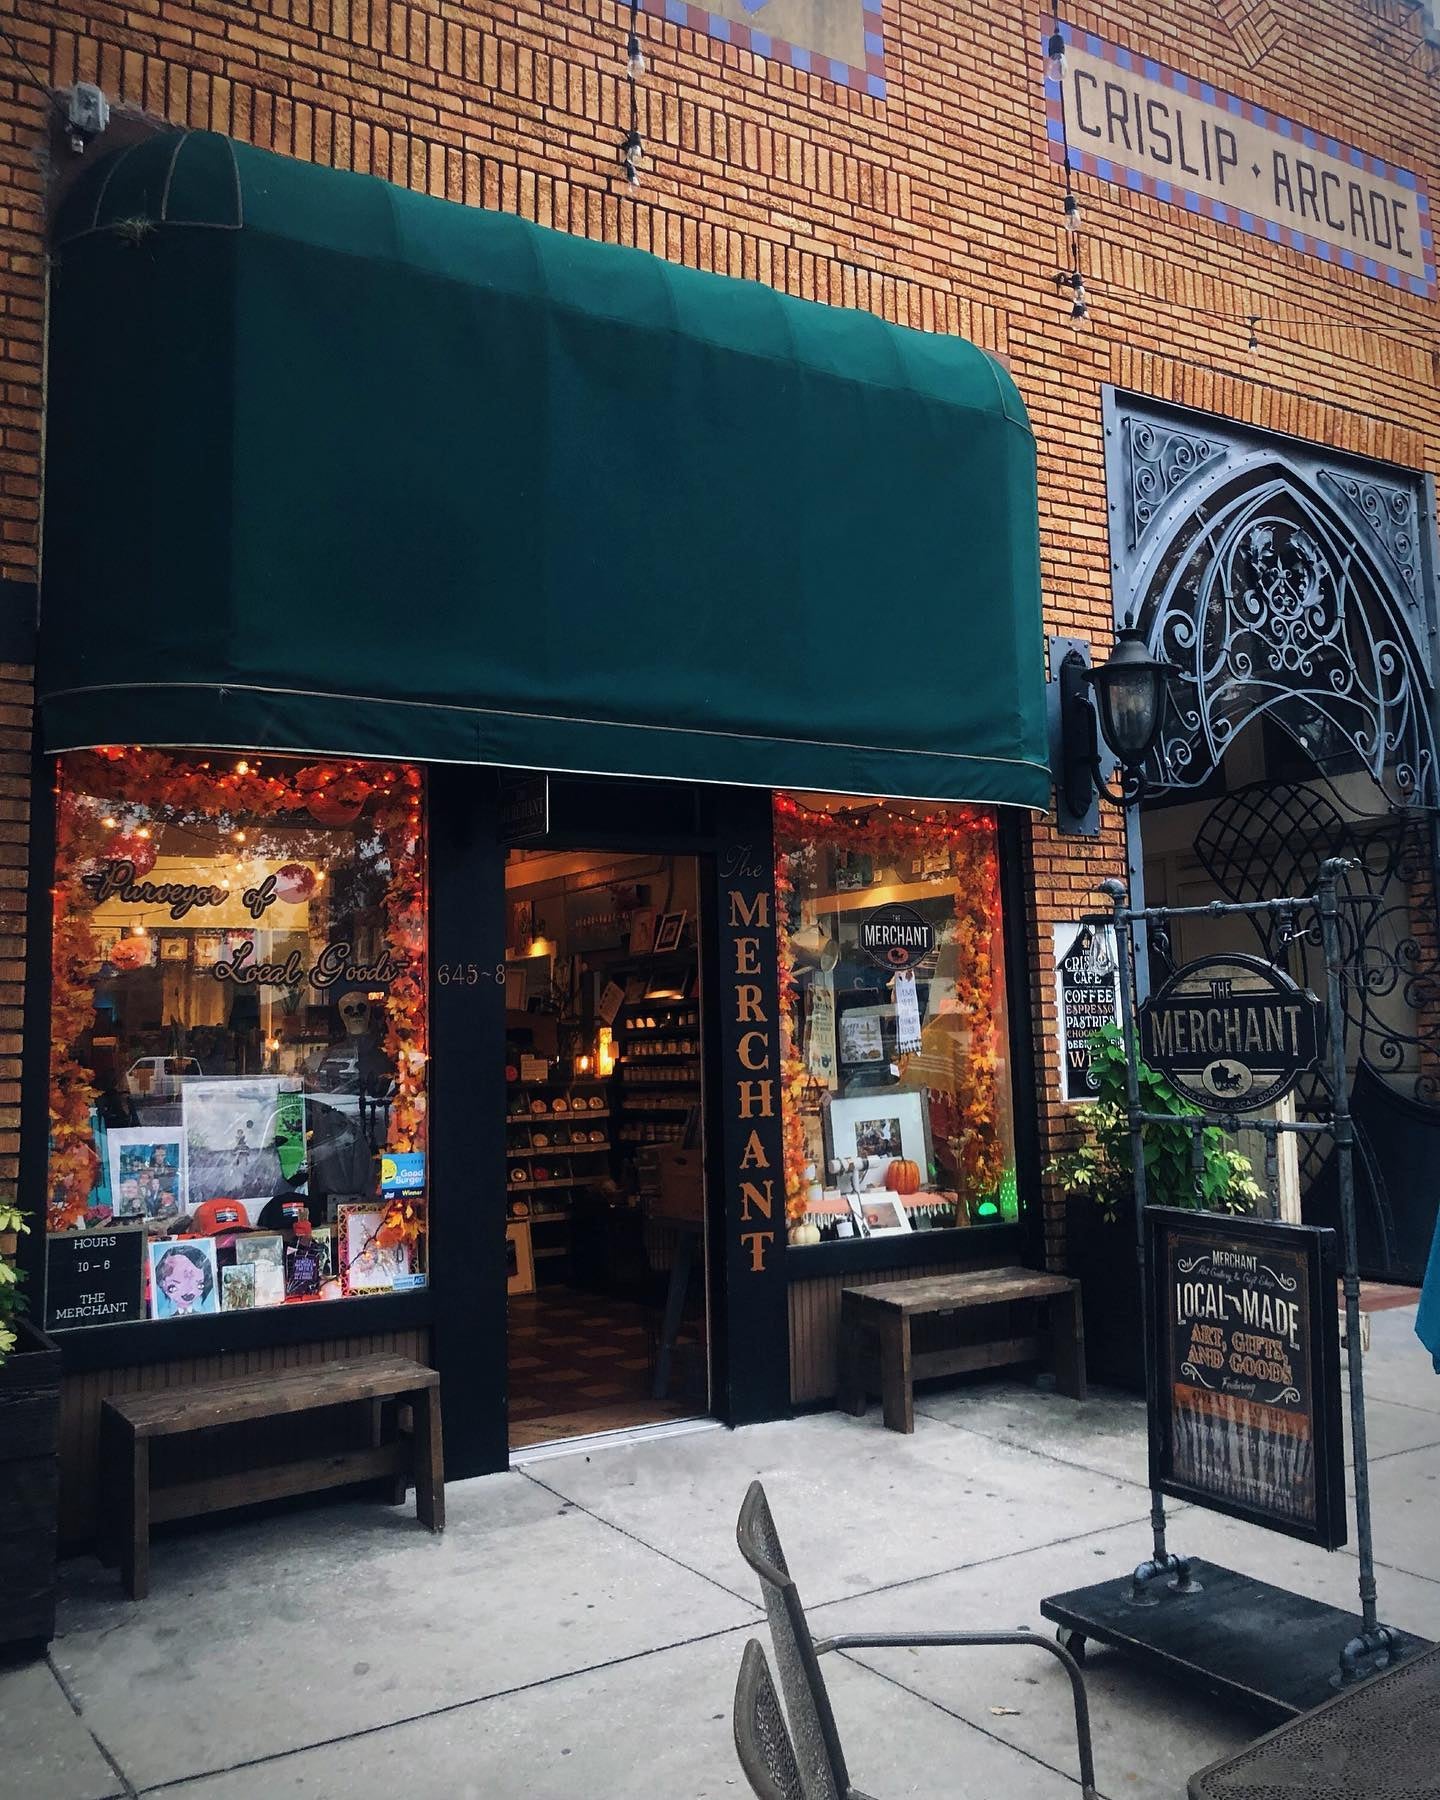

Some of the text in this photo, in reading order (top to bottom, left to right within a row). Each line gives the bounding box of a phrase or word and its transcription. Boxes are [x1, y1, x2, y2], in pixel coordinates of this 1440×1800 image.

[1074, 68, 1413, 259] CRISLIP ARCADE
[719, 843, 763, 878] The
[98, 860, 277, 920] Purveyor of
[865, 925, 928, 948] MERCHANT
[214, 940, 397, 988] Local Goods
[1065, 989, 1114, 1003] COFFEE
[1211, 981, 1231, 999] THE
[1066, 1004, 1114, 1016] ESPRESSO
[1150, 1005, 1301, 1057] MERCHANT
[727, 891, 775, 1272] MERCHANT
[401, 1169, 424, 1177] Good
[74, 1236, 117, 1249] HOURS
[78, 1262, 89, 1272] 10
[1212, 1250, 1258, 1273] MERCHANT
[80, 1293, 106, 1304] THE
[56, 1302, 128, 1320] MERCHANT
[1177, 1282, 1300, 1350] LOCAL MADE
[1187, 1344, 1293, 1386] AND GOODS
